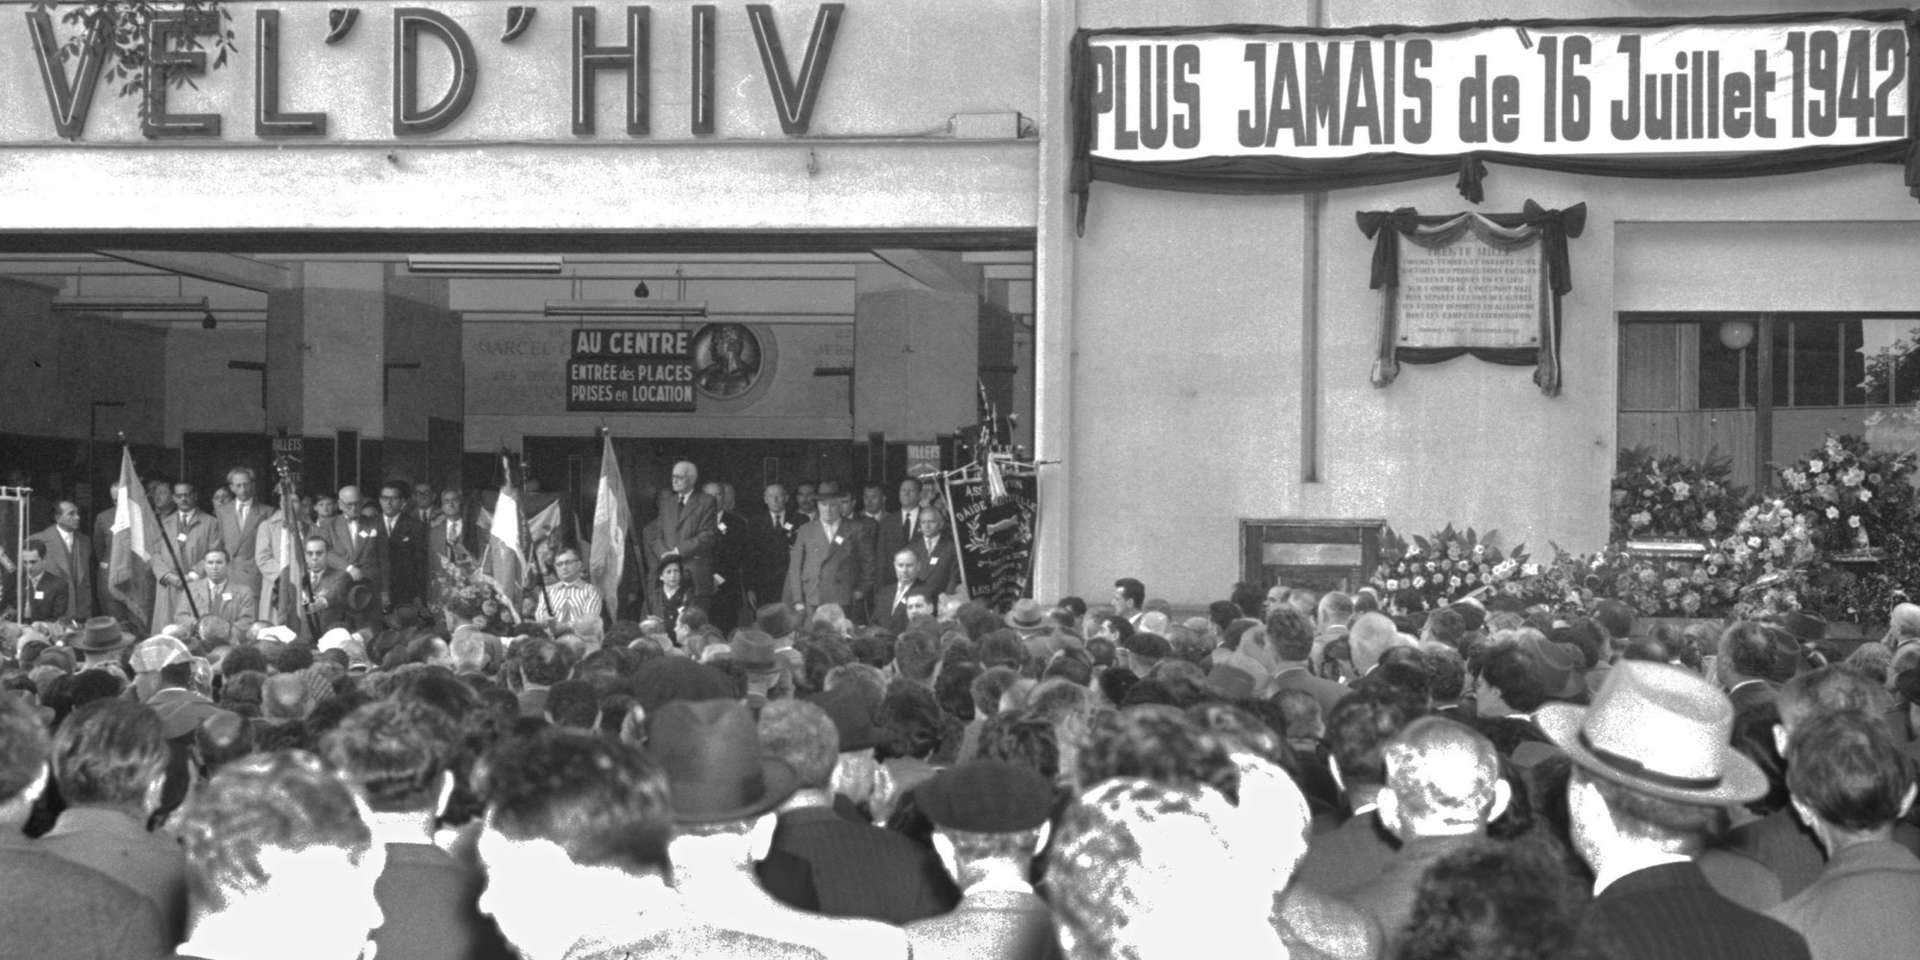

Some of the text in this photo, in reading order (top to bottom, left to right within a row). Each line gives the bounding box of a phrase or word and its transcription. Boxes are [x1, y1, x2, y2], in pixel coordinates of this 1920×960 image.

[1090, 43, 1201, 151] PLUS
[1238, 39, 1433, 148] JAMAIS
[1458, 54, 1520, 144] de
[1610, 34, 1777, 141] Juillet
[1785, 28, 1906, 138] 1942
[576, 331, 602, 354] AU
[609, 331, 688, 354] CENTRE
[571, 363, 618, 381] ENTRÉE
[619, 365, 636, 381] des
[638, 364, 693, 381] PLACES
[571, 384, 613, 402] PRISES
[615, 389, 629, 402] en
[632, 385, 693, 403] LOCATION
